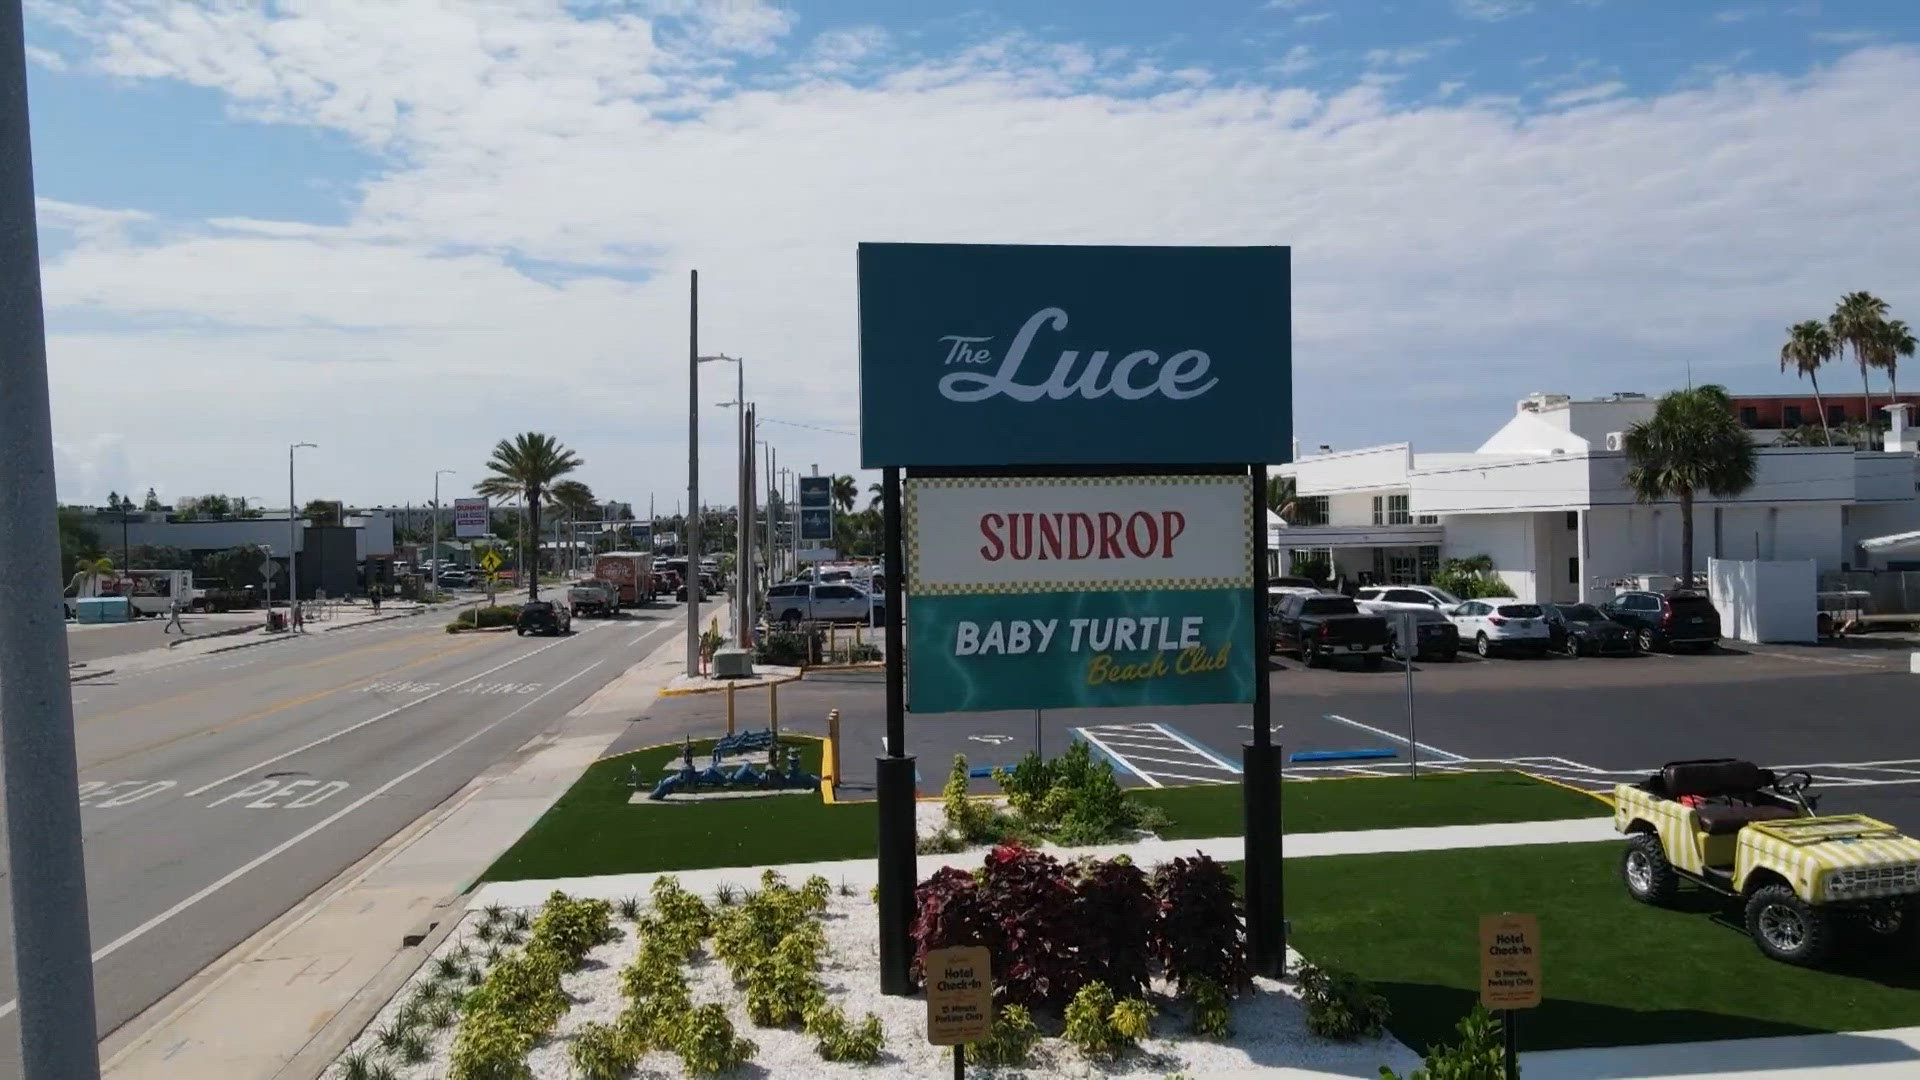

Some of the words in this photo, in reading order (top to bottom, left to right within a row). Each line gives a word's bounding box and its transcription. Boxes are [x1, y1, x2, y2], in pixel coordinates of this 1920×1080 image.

[938, 335, 994, 365] The
[938, 307, 1219, 402] Luce
[980, 511, 1186, 561] SUNDROP
[955, 618, 1058, 656] BABY
[1069, 616, 1204, 652] TURTLE
[1087, 651, 1169, 685] Beach
[1175, 641, 1232, 675] Club
[206, 780, 350, 808] PED
[1497, 933, 1524, 944] Hotel
[1489, 946, 1532, 955] Check-In
[945, 968, 973, 979] Hotel
[1488, 978, 1514, 988] Parking
[1516, 978, 1534, 987] Only
[937, 979, 982, 991] Check-In
[935, 1014, 963, 1023] Parking
[965, 1013, 983, 1022] Only
